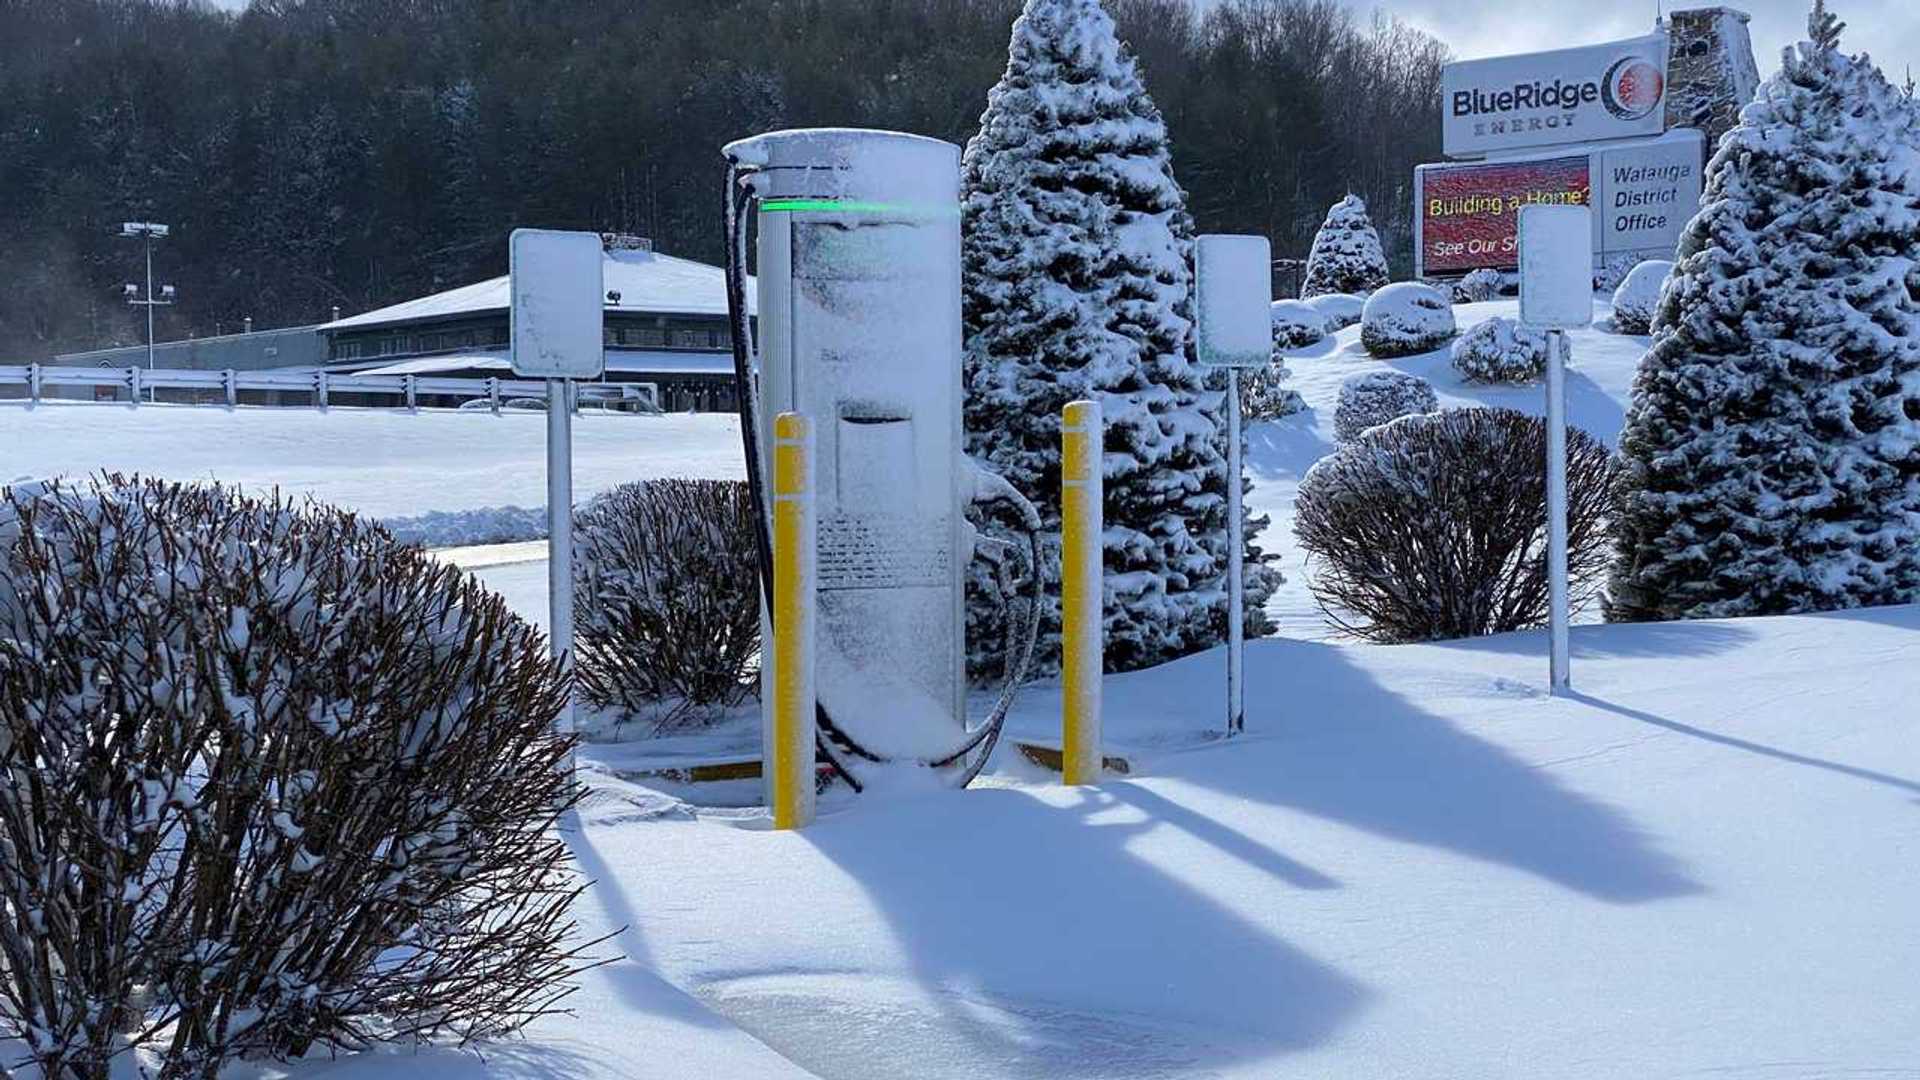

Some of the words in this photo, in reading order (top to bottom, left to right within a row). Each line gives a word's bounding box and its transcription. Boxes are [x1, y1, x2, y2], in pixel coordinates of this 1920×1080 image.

[1453, 79, 1598, 116] BlueRidge
[1473, 113, 1576, 136] ENERGY
[1614, 165, 1691, 183] Watauga
[1430, 191, 1502, 216] Building
[1509, 195, 1519, 210] a
[1615, 188, 1677, 208] District
[1615, 213, 1667, 232] Office
[1434, 241, 1464, 256] See
[1467, 237, 1497, 254] Our
